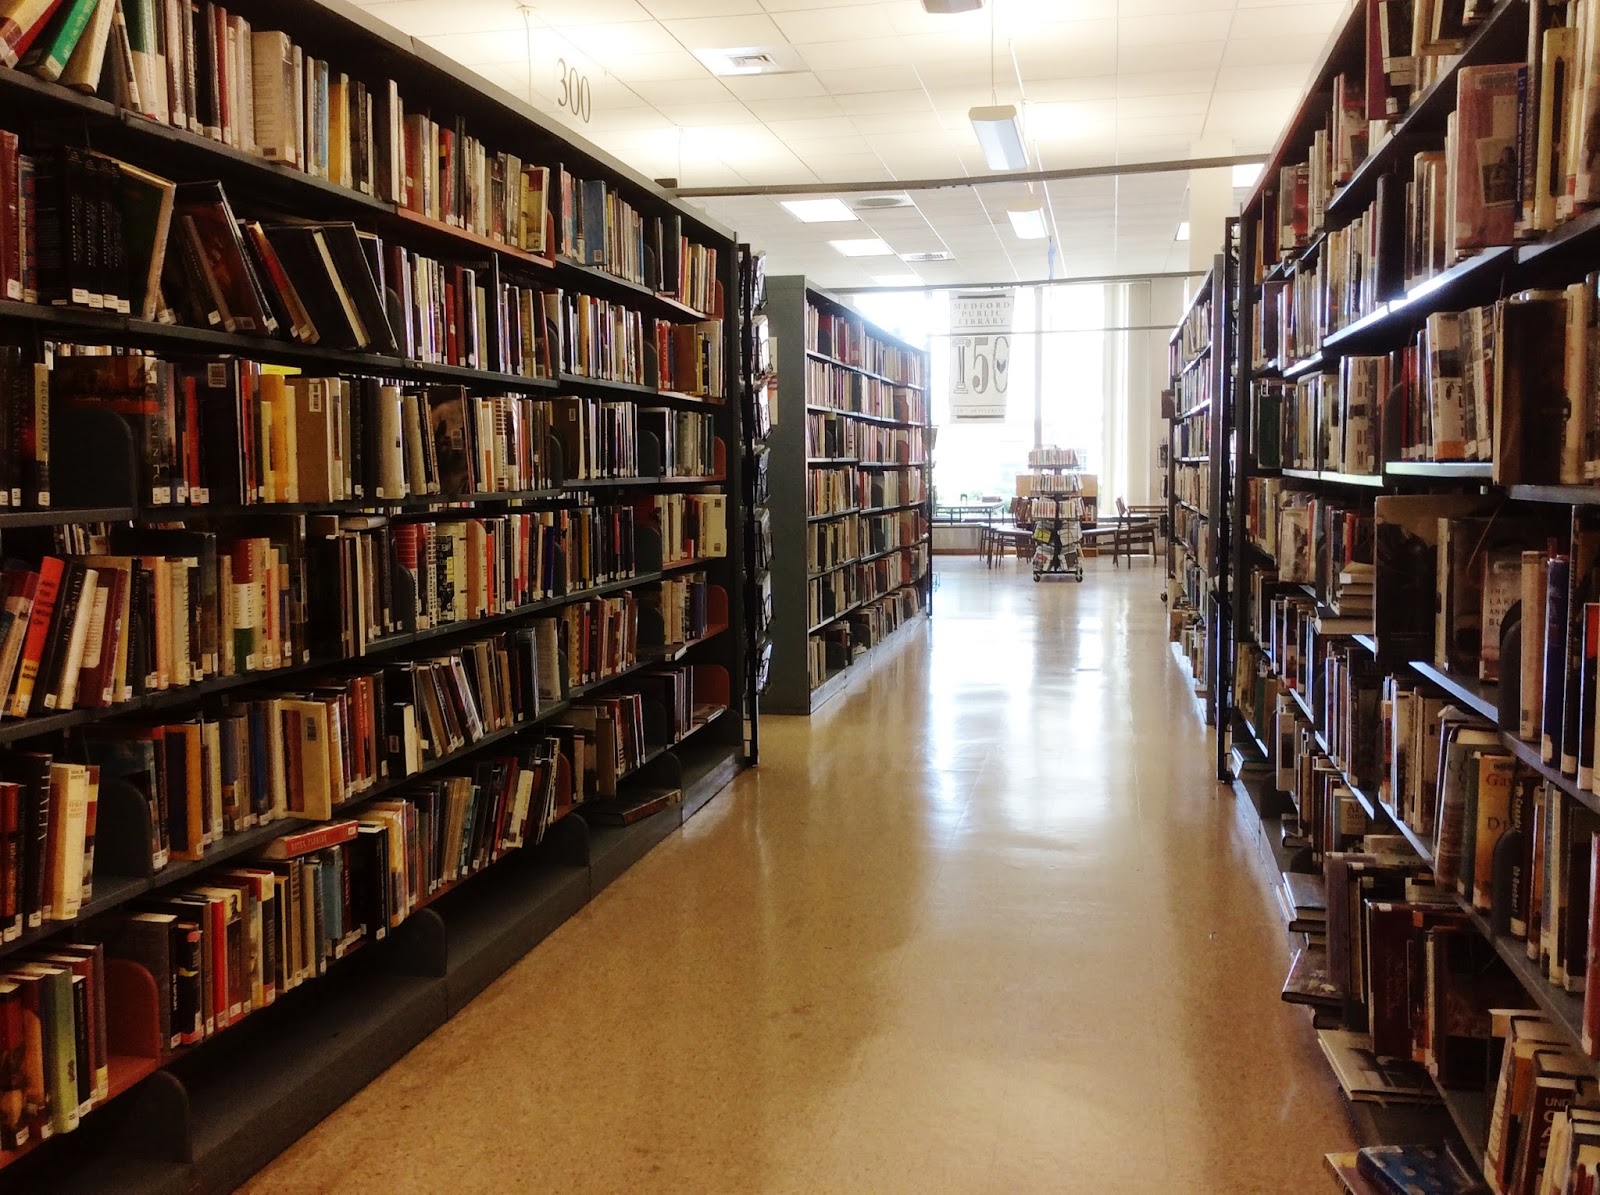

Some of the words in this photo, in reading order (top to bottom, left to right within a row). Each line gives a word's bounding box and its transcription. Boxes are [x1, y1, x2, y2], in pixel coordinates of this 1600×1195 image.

[557, 57, 591, 123] 300
[954, 302, 1010, 310] MEDFORD
[959, 317, 1005, 325] LIBRARY
[951, 336, 1009, 394] 150
